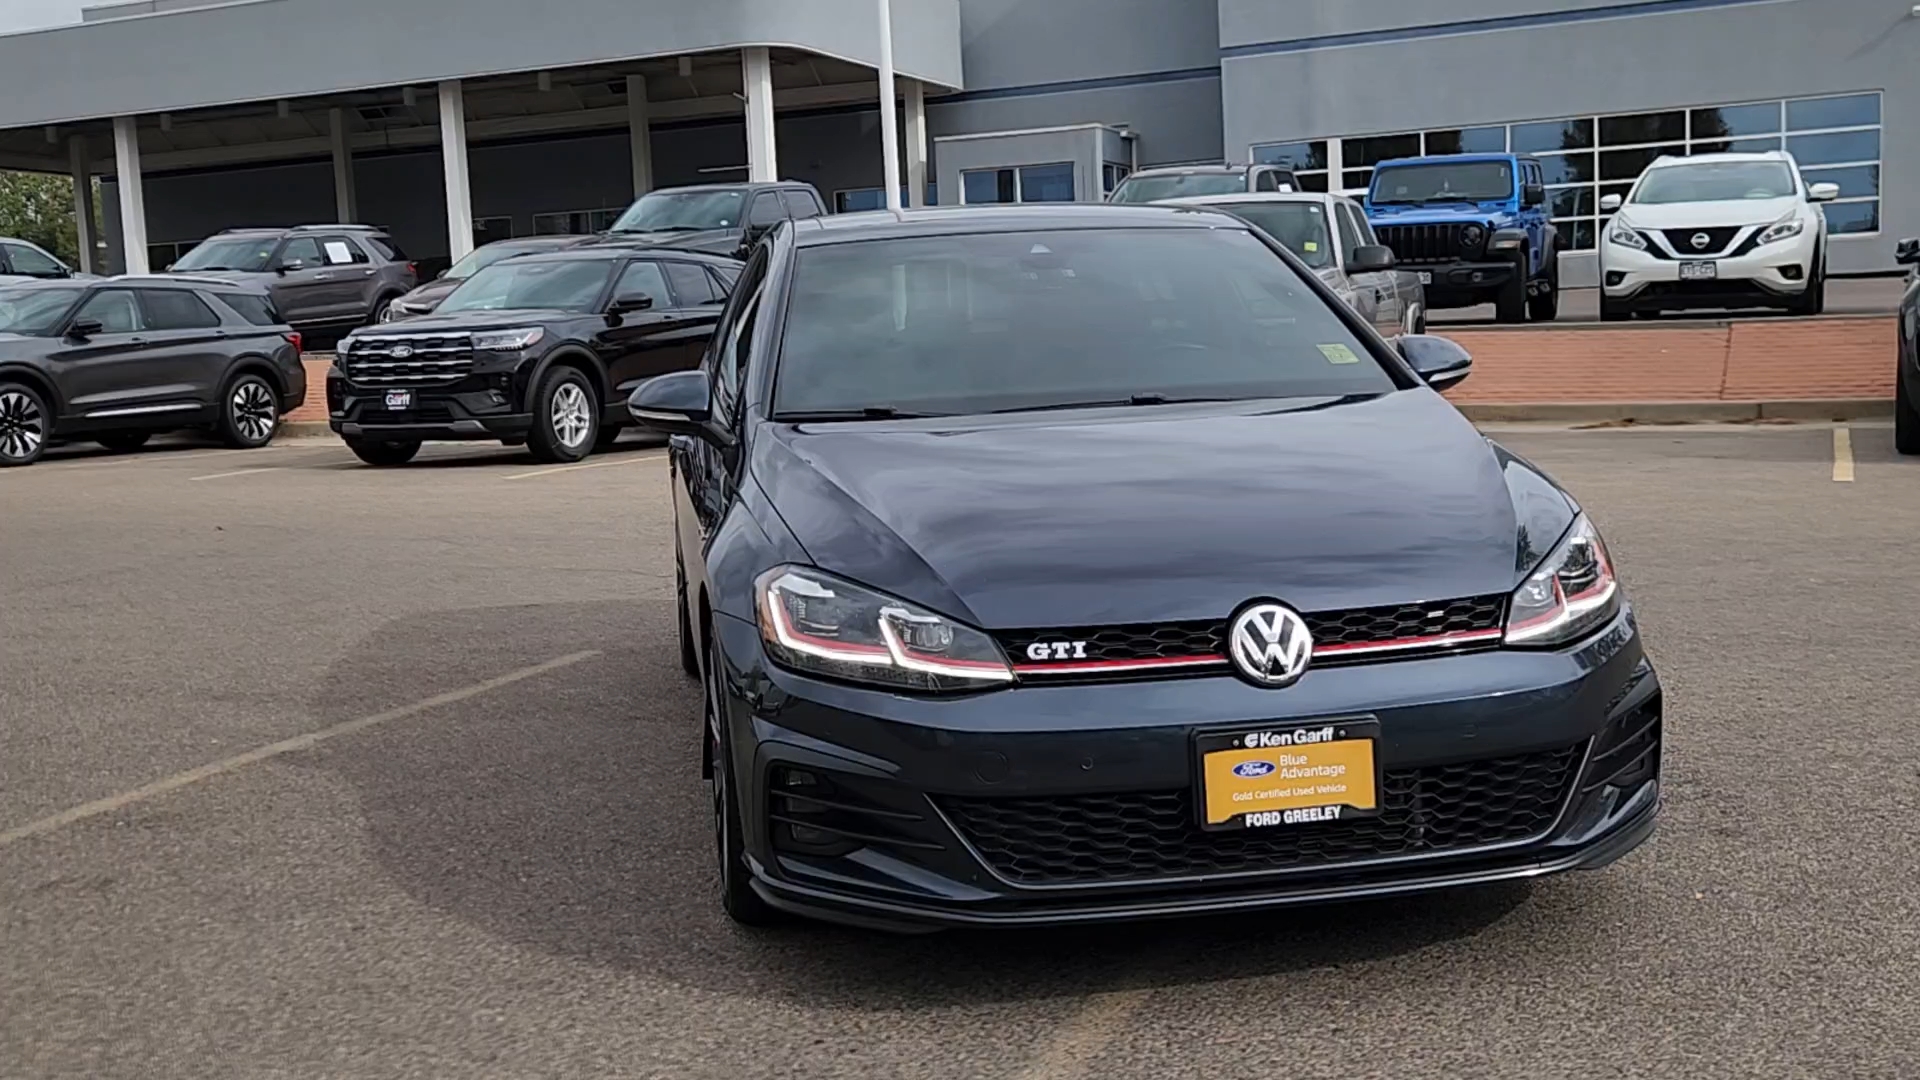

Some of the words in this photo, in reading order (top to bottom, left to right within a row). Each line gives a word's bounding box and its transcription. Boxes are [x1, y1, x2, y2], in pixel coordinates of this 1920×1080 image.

[1026, 641, 1087, 660] GTI
[1260, 731, 1292, 747] Ken
[1293, 727, 1335, 744] Garff
[1239, 762, 1269, 776] Ford
[1280, 754, 1308, 766] Blue
[1280, 763, 1346, 779] Advantage
[1232, 791, 1253, 801] Gold
[1254, 787, 1291, 799] Certified
[1292, 785, 1315, 797] Used
[1316, 783, 1347, 795] Vehicle
[1245, 811, 1281, 827] FORD
[1283, 805, 1342, 824] GREELEY
